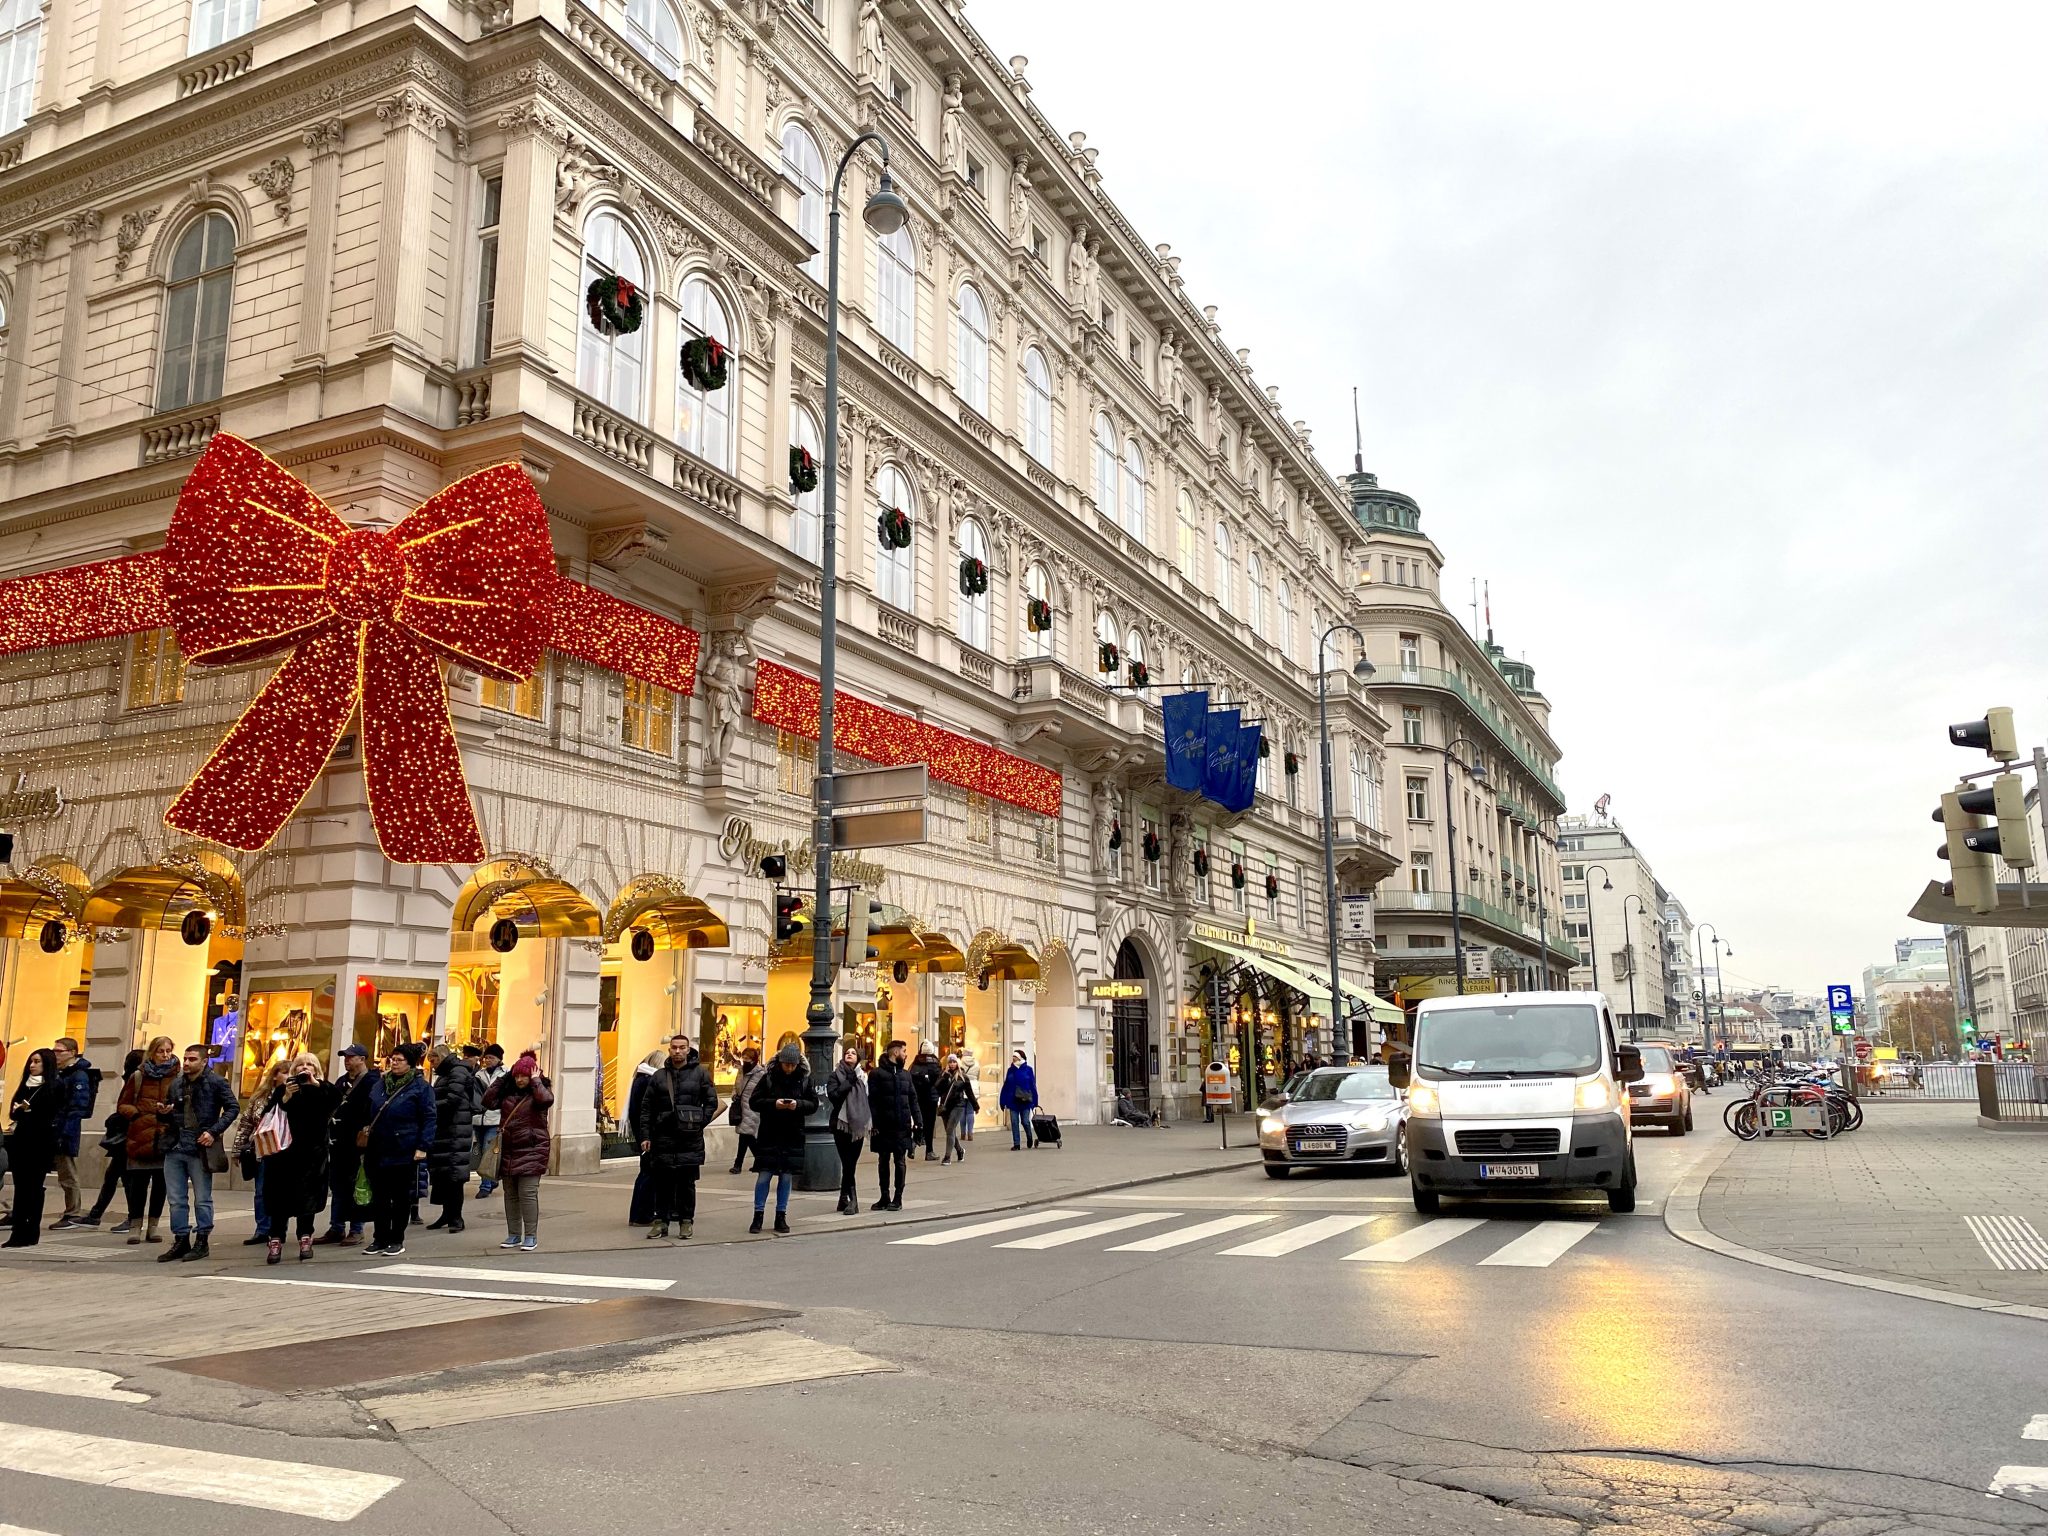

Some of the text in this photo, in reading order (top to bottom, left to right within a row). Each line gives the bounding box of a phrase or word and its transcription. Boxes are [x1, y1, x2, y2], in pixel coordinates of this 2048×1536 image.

[1966, 838, 1977, 846] 13
[1832, 992, 1847, 1007] P
[1772, 1111, 1786, 1126] P
